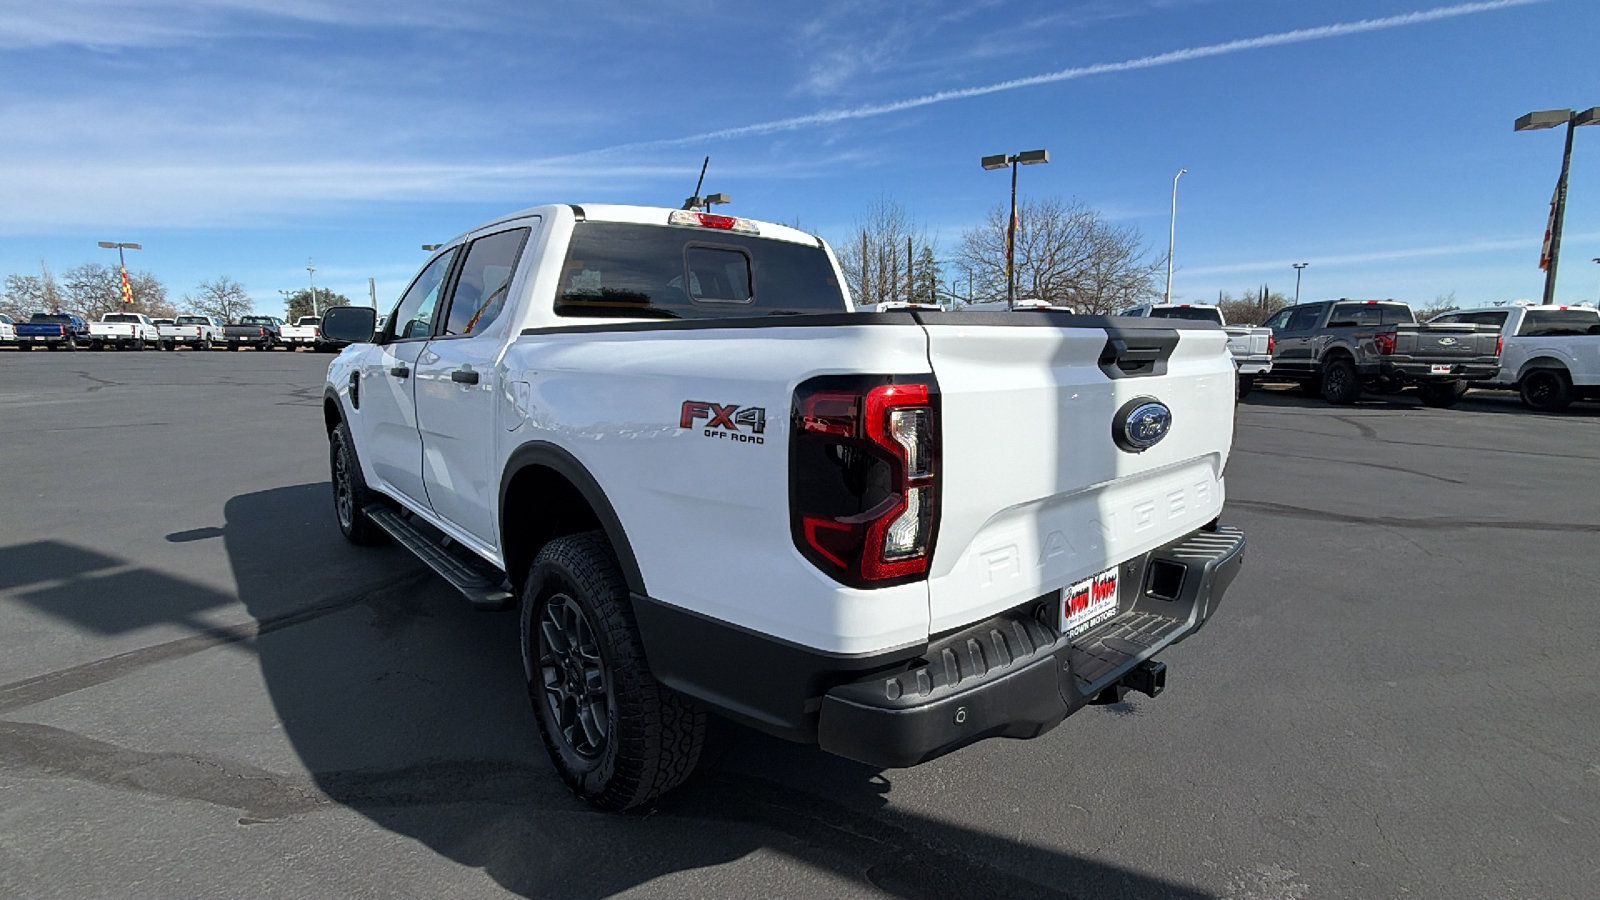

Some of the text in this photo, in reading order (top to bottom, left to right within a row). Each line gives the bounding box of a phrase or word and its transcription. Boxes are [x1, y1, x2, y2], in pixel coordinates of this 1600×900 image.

[680, 400, 766, 434] FX4
[704, 429, 765, 445] OFF ROAD
[979, 479, 1211, 588] RANGER
[1066, 621, 1090, 639] CROWN
[1090, 607, 1117, 627] MOTORS
